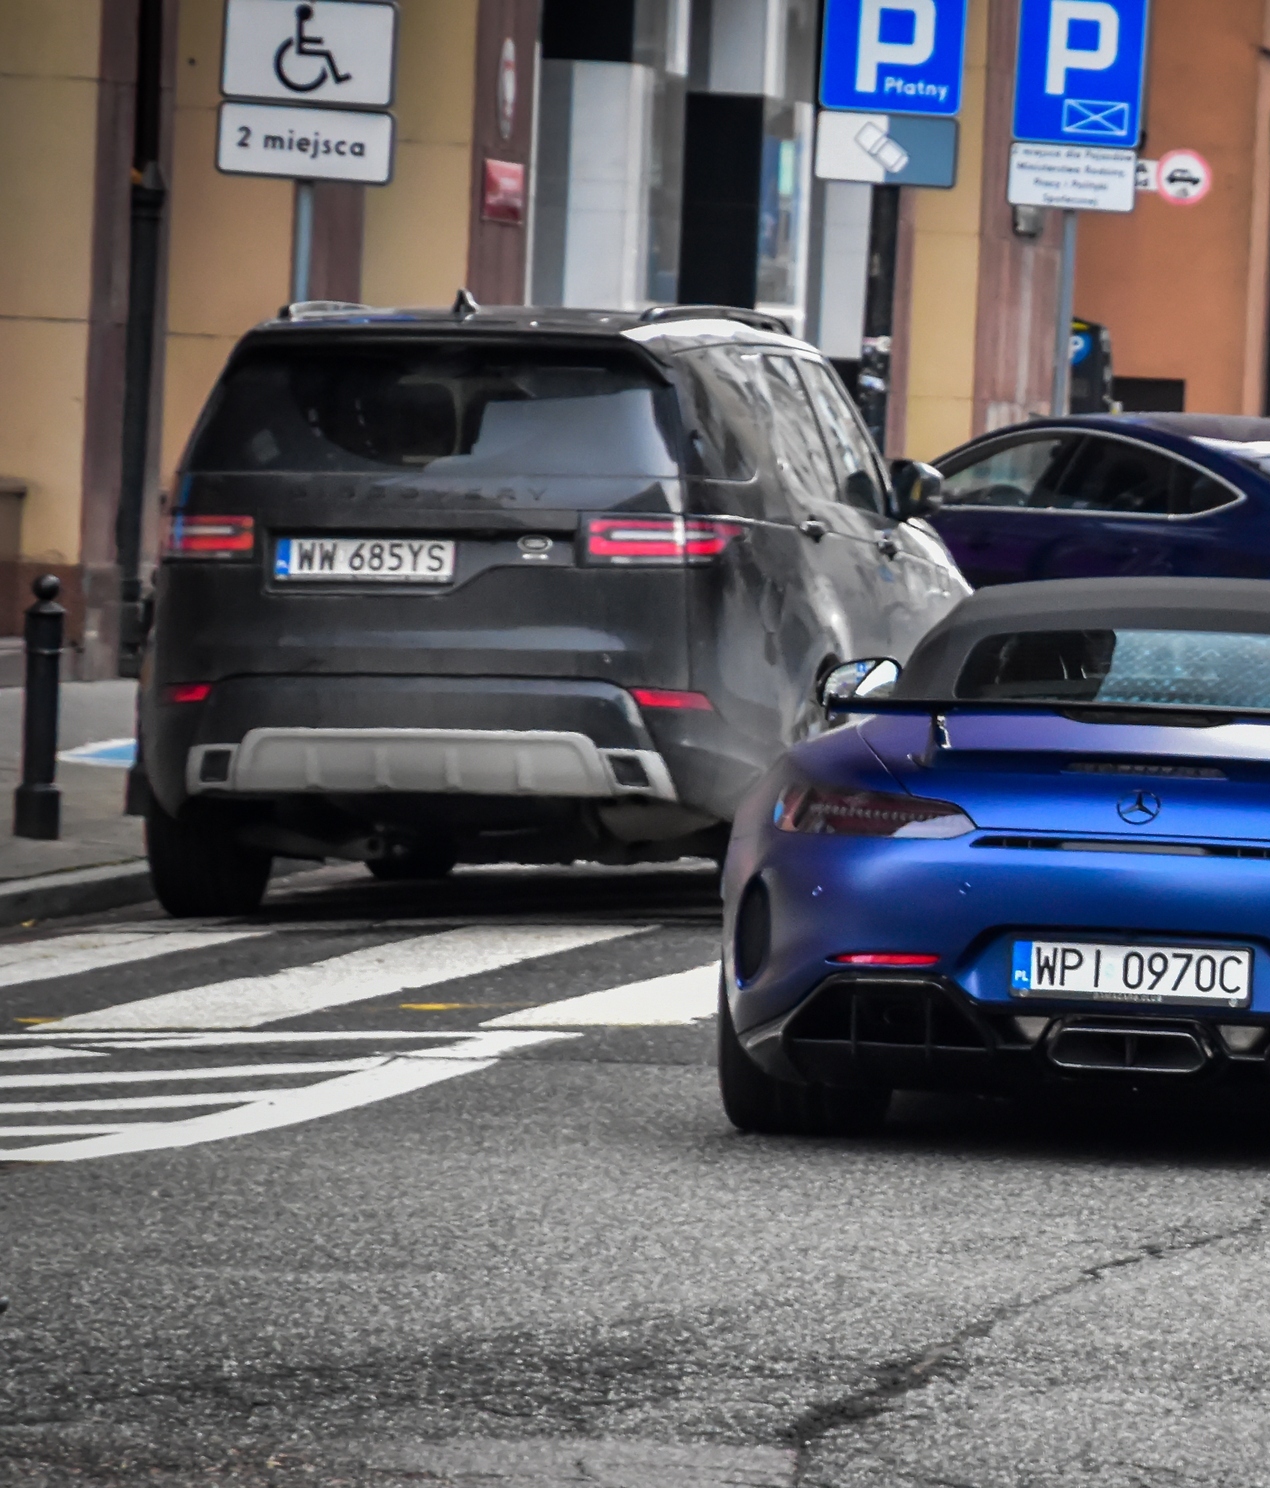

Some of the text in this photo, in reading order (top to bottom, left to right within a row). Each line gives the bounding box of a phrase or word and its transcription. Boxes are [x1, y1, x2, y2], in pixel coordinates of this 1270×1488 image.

[855, 0, 936, 93] P
[1045, 1, 1119, 95] P
[884, 76, 948, 102] Płatny
[237, 126, 366, 159] 2 miejsca
[299, 541, 445, 572] WW 685YS
[1014, 970, 1029, 982] PL
[1036, 946, 1242, 994] WPI 0970C
